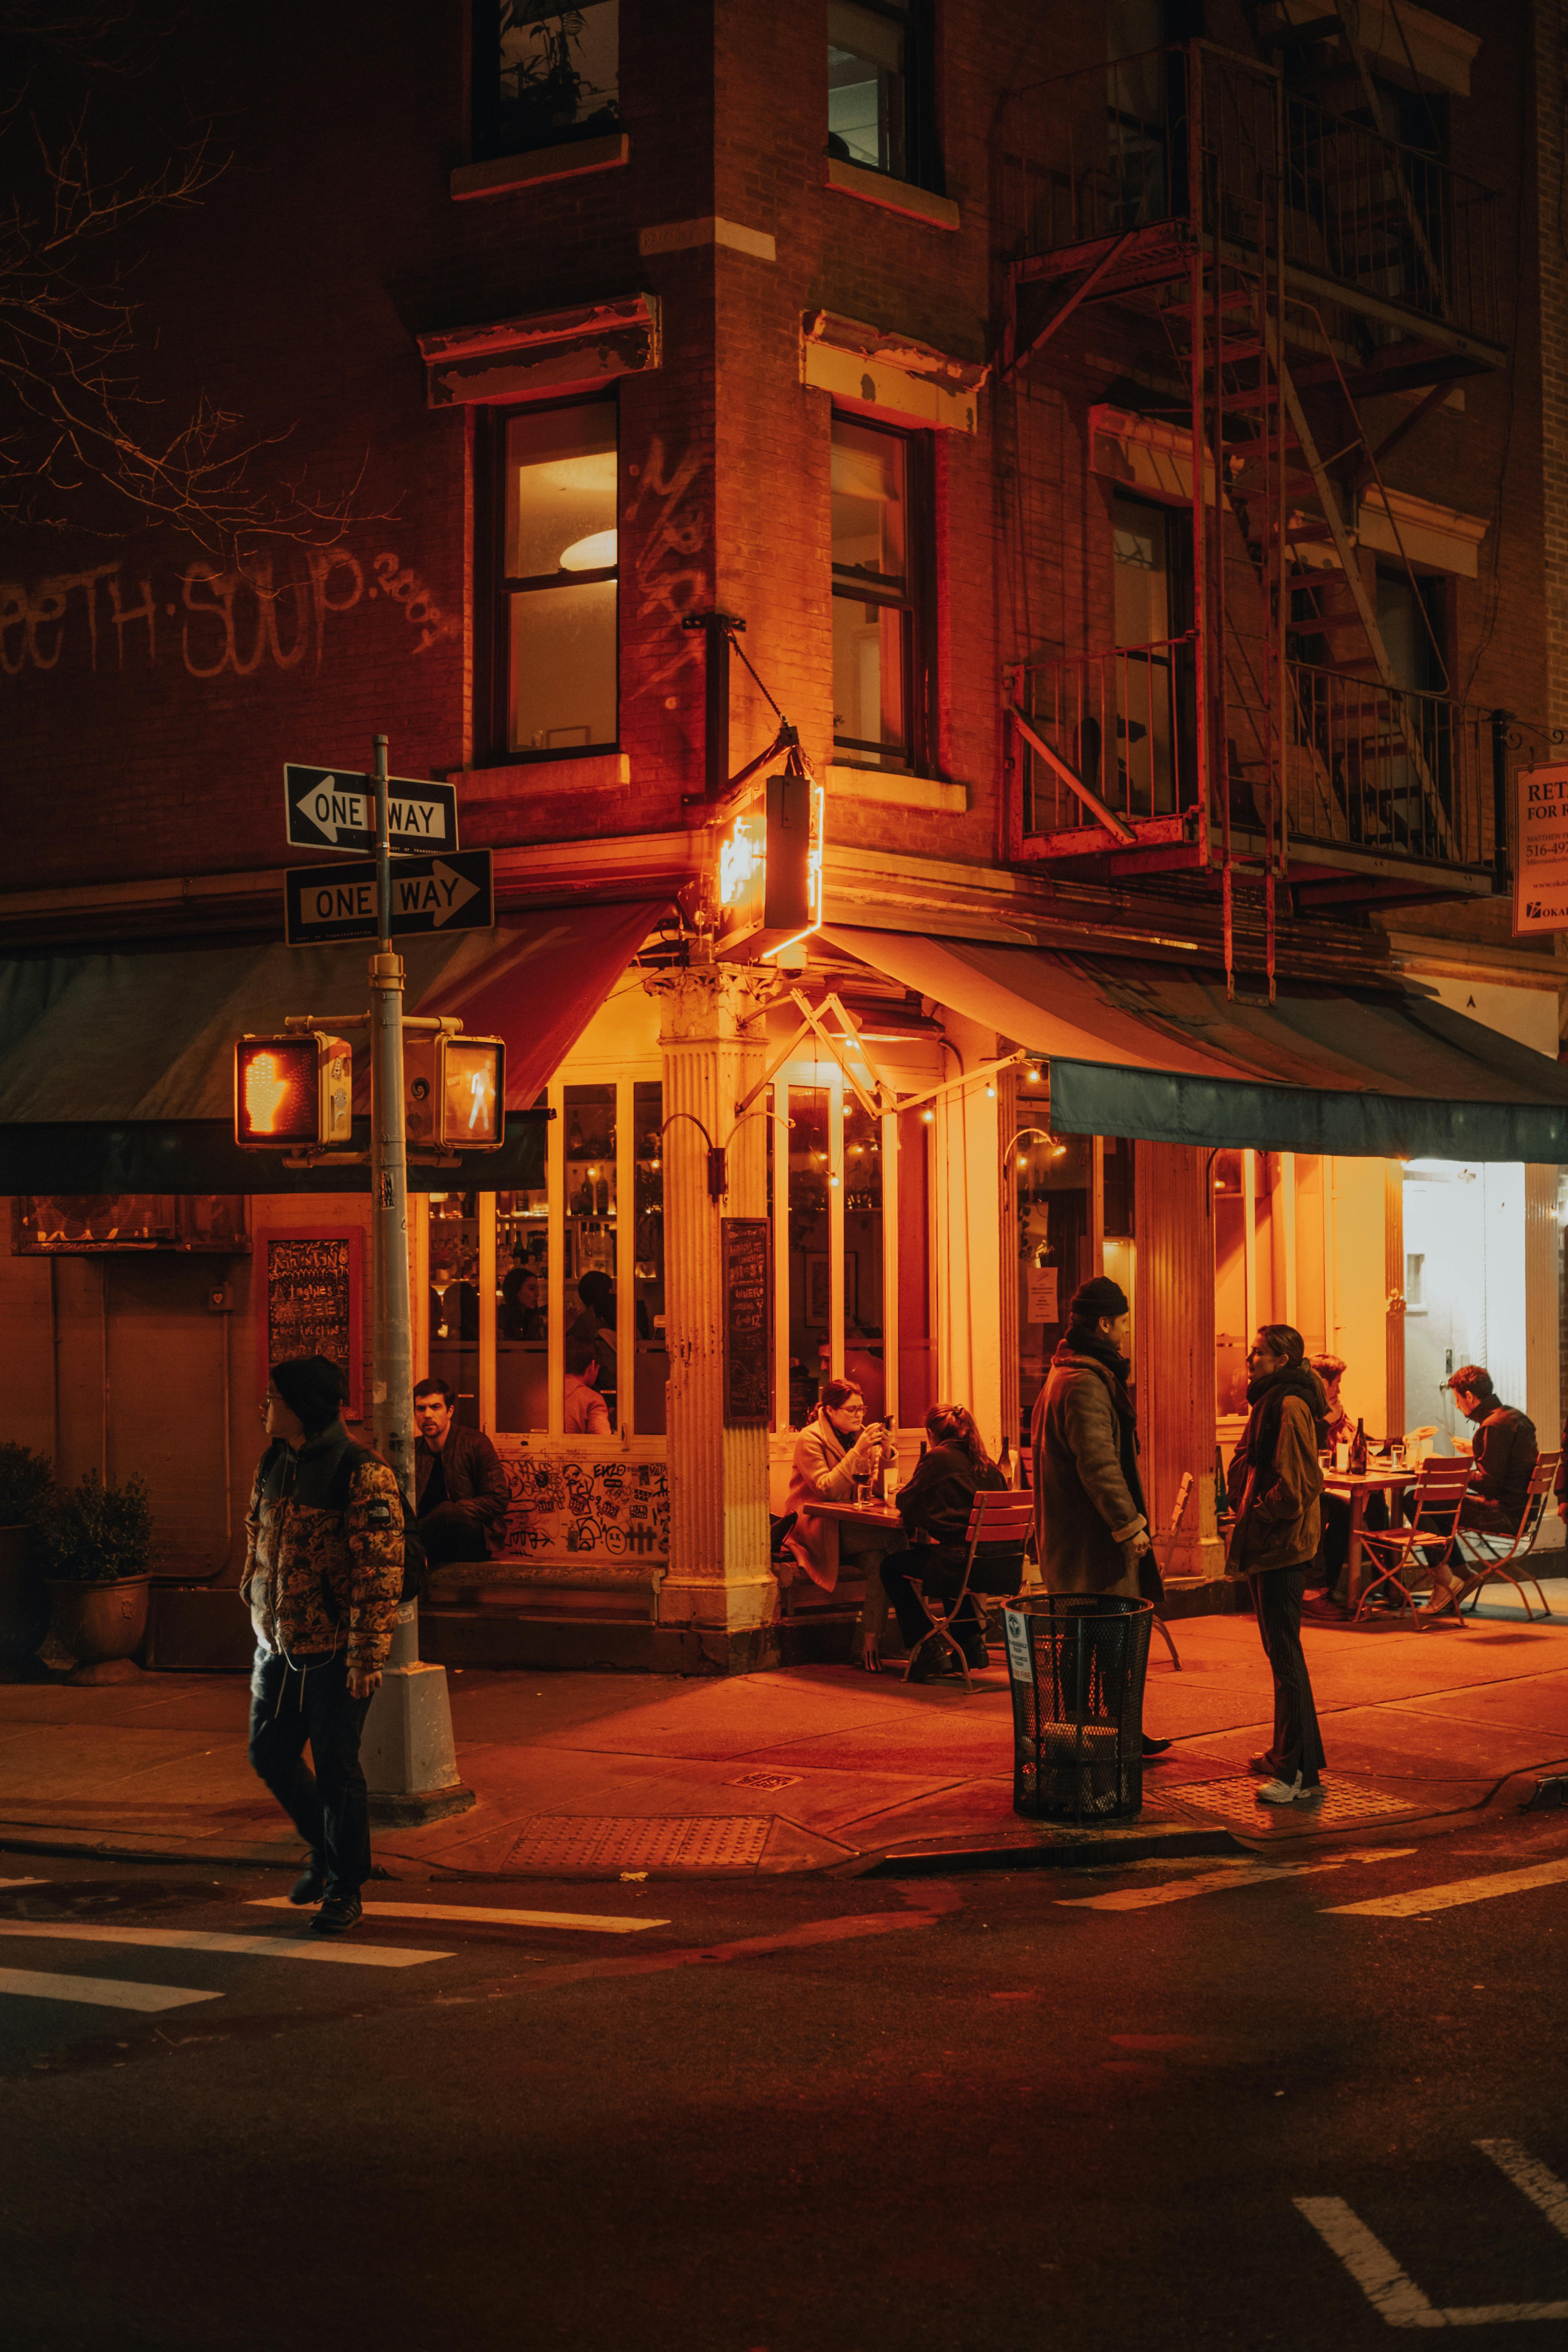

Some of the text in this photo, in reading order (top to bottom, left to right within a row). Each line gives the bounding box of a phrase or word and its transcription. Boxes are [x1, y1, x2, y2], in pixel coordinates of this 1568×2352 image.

[1528, 781, 1568, 802] RET
[315, 793, 434, 833] ONE WAY
[1528, 805, 1557, 820] FOR
[1527, 833, 1560, 842] MATTHEW
[317, 878, 459, 919] ONE WAY
[1543, 907, 1568, 917] OKA
[1020, 1671, 1032, 1680] FINE
